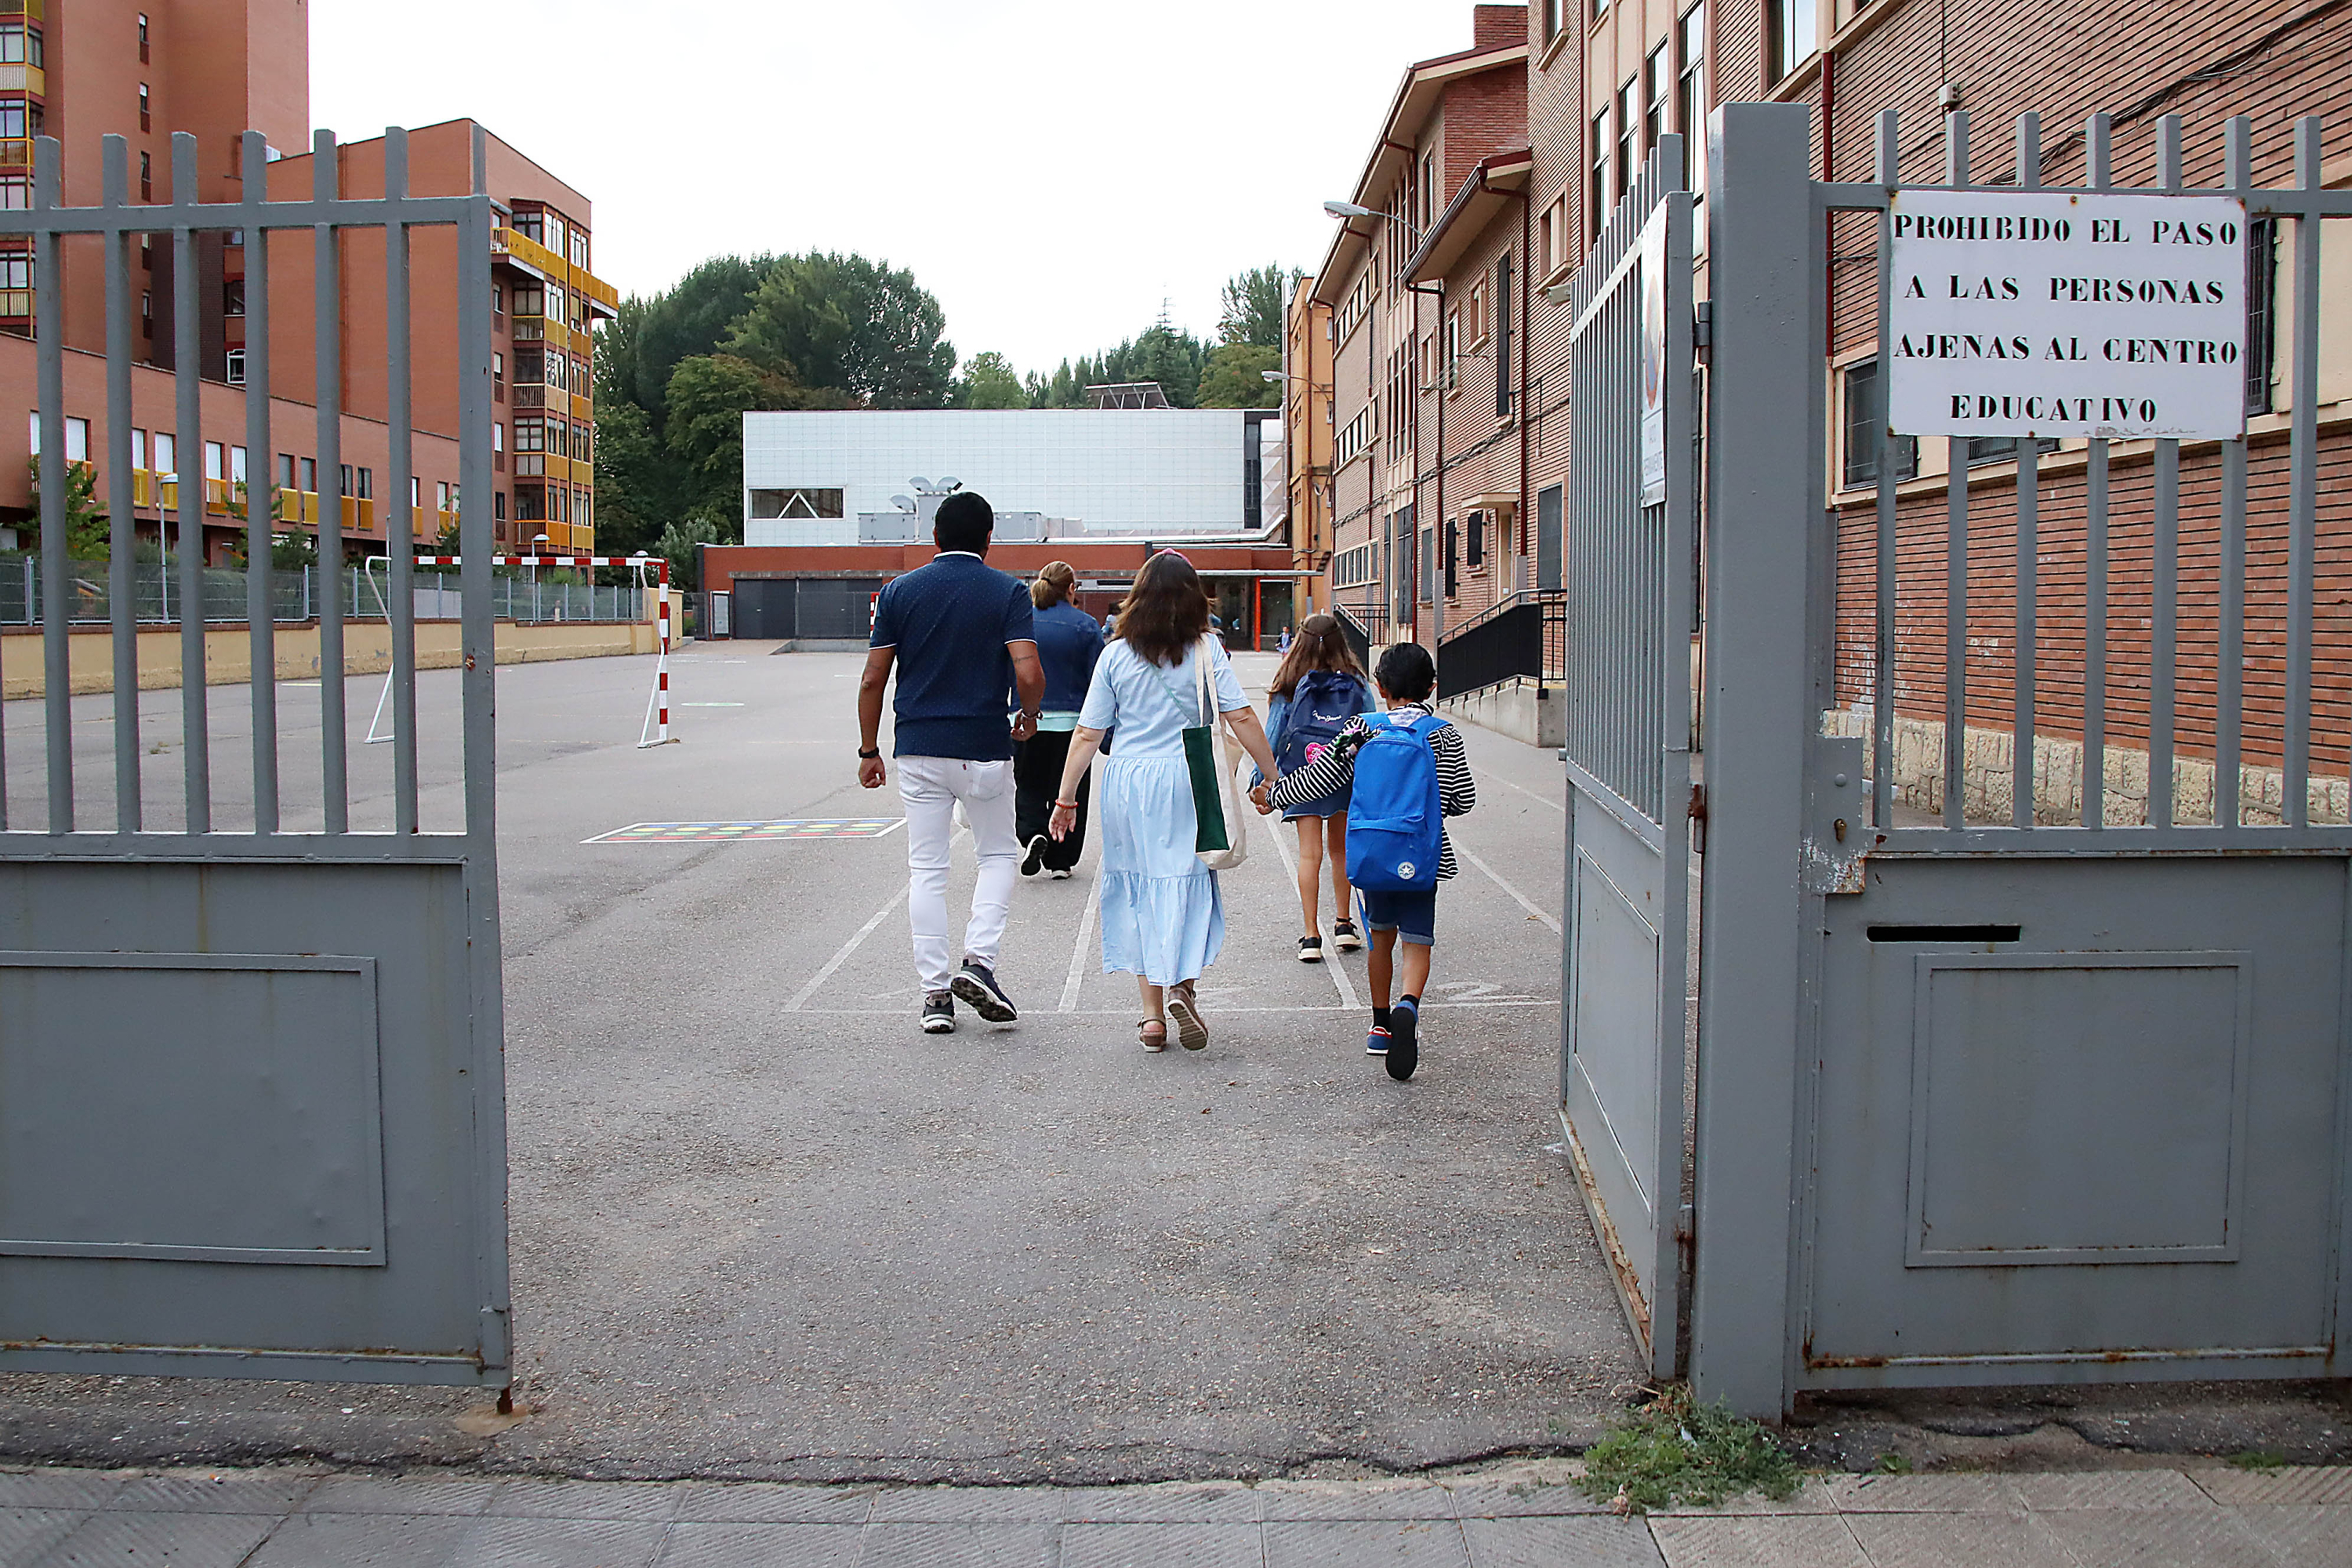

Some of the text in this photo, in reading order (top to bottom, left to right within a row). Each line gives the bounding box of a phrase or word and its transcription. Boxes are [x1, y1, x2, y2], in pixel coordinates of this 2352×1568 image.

[1895, 214, 2237, 246] PROHIBIDO EL PASO
[1904, 274, 2224, 304] A LAS PERSONAS
[1893, 333, 2238, 365] AJENAS AL CENTRO
[1951, 394, 2156, 423] EDUCATIVO
